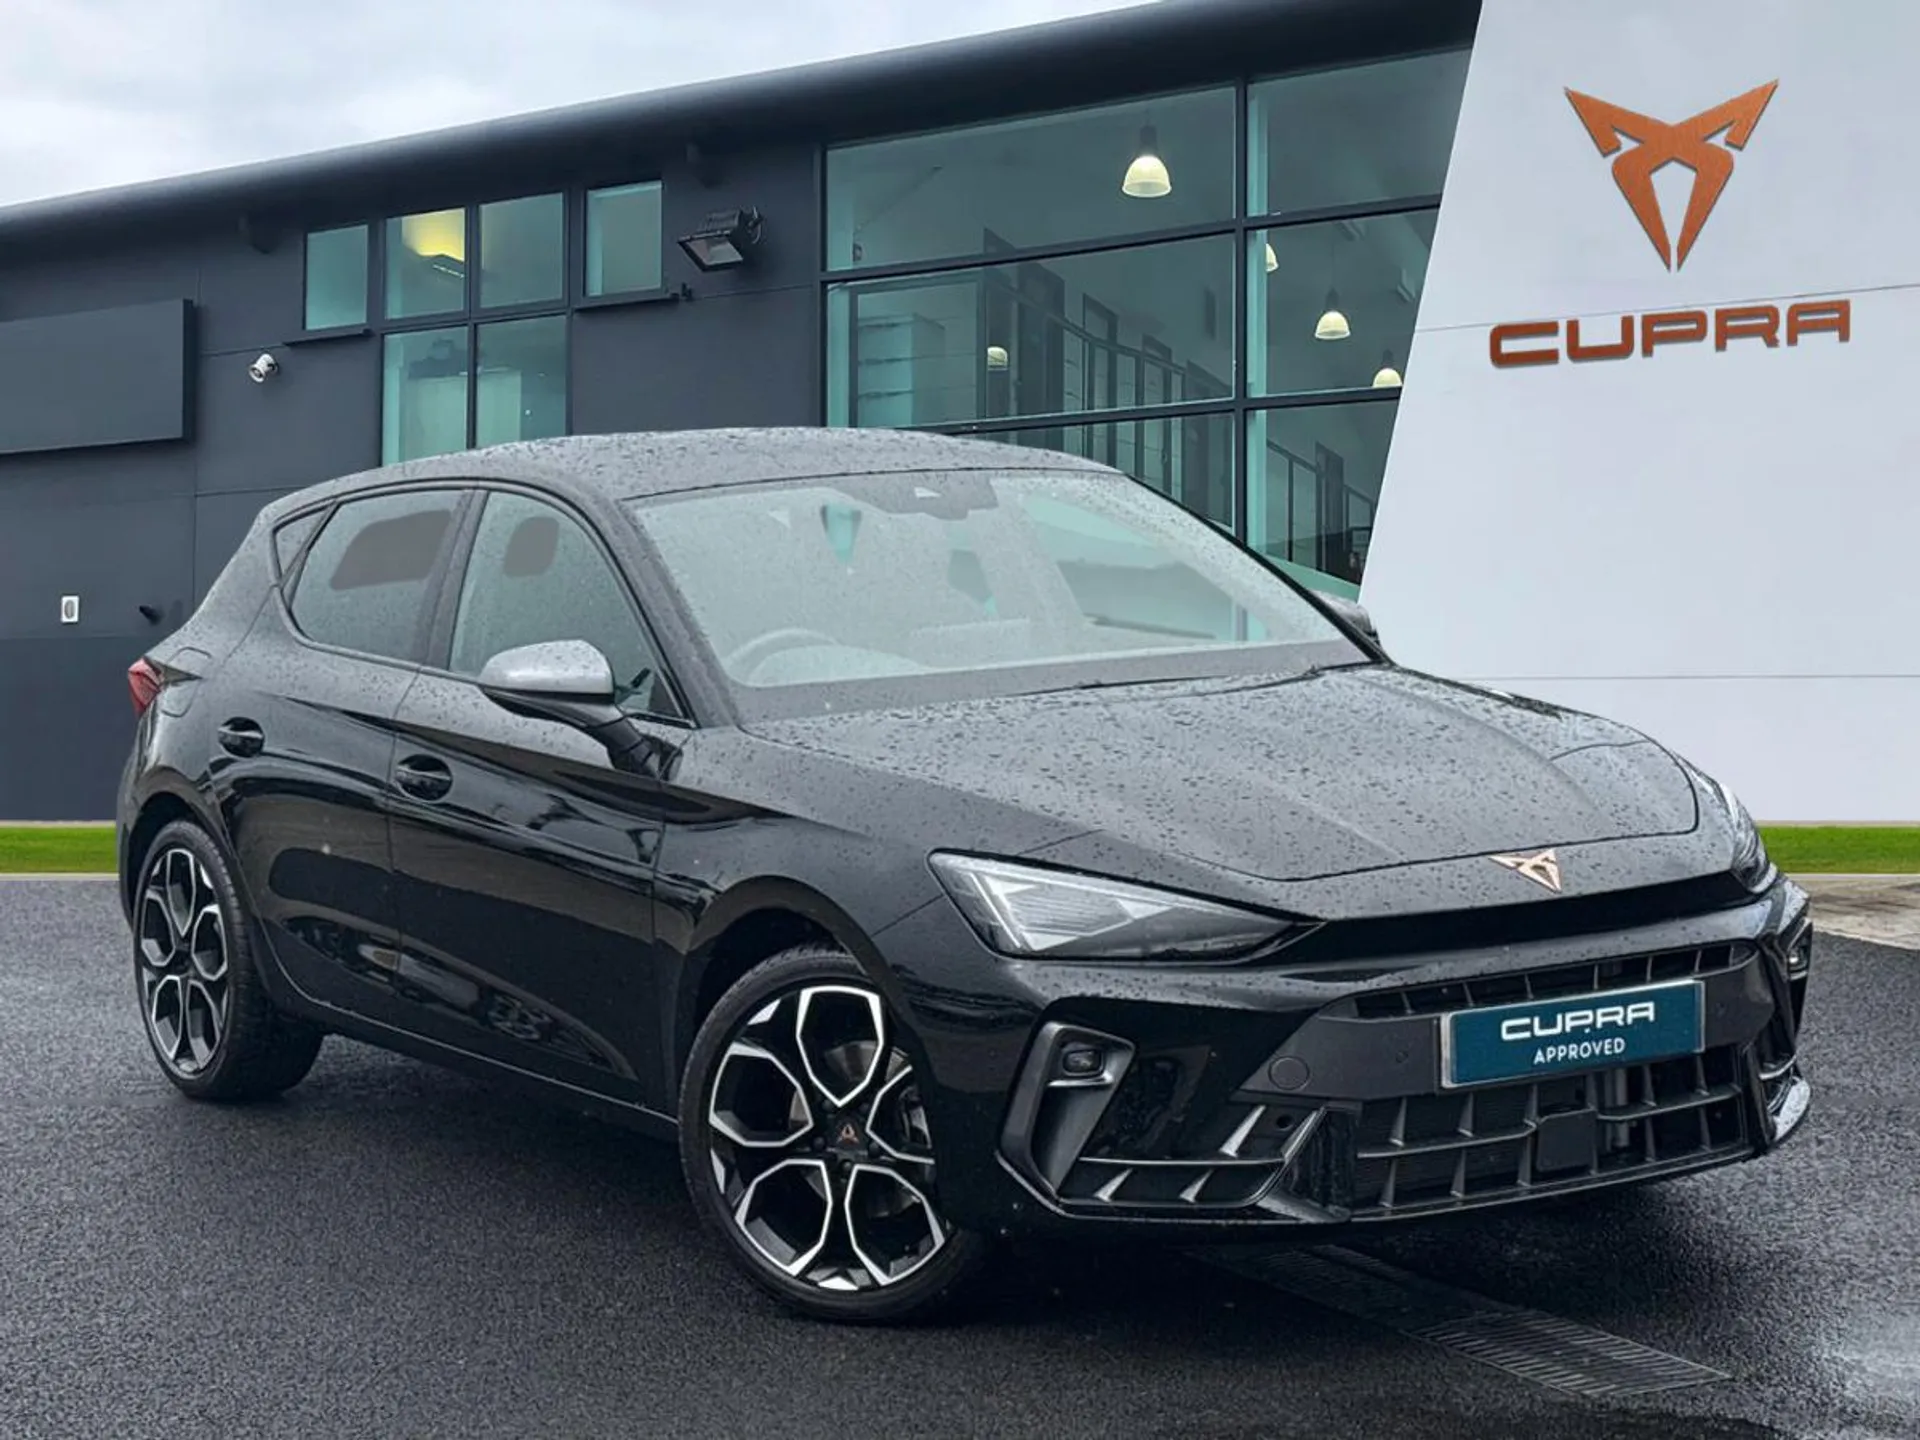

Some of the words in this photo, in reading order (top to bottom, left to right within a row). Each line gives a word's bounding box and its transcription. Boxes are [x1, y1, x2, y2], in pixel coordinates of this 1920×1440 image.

[1490, 299, 1851, 368] CUPRA
[1501, 1001, 1656, 1041] CUPRA
[1533, 1037, 1626, 1065] APPROVED
